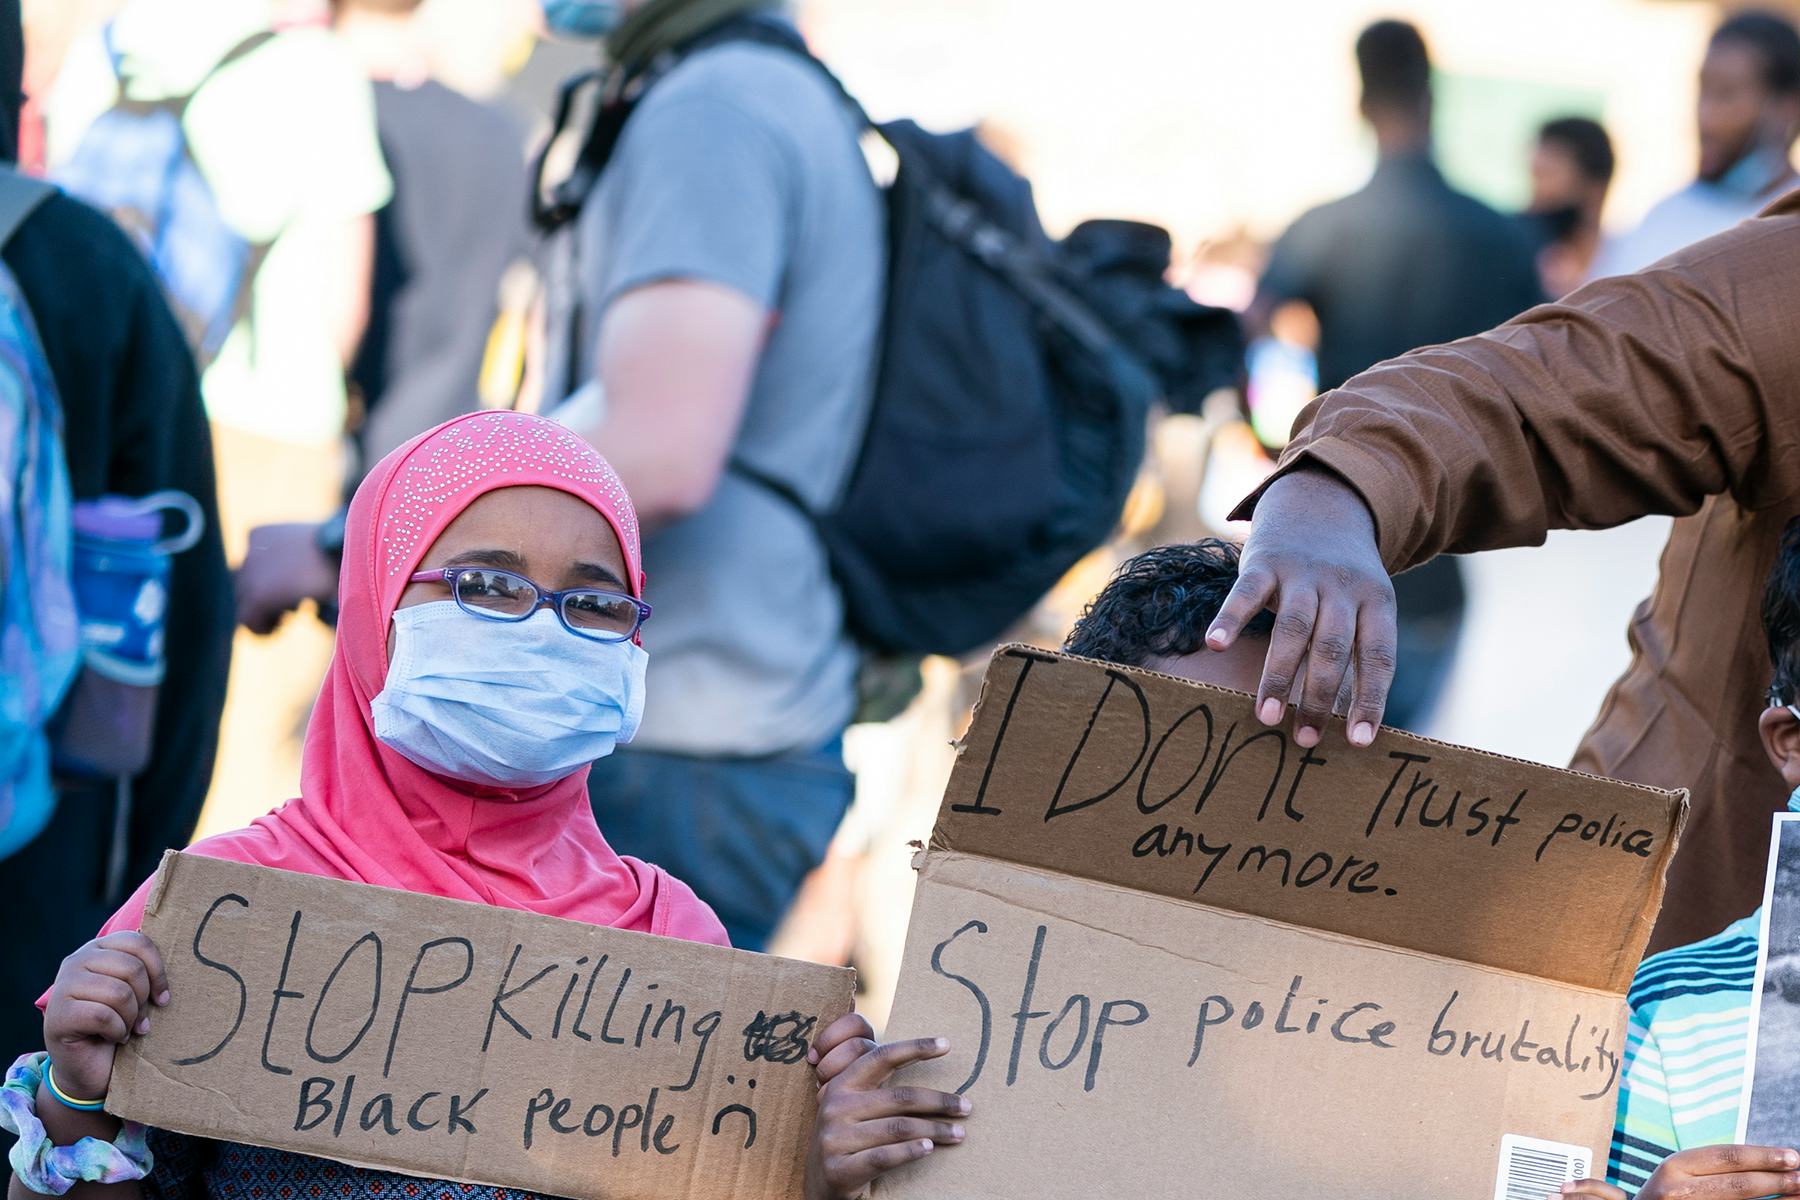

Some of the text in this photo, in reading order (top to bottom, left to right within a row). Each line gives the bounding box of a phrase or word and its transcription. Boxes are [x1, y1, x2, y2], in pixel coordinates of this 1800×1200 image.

[951, 653, 1059, 817] I
[1366, 751, 1522, 848] Trust
[1534, 813, 1654, 862] police
[1187, 975, 1398, 1069] police
[1426, 990, 1620, 1101] brutality
[292, 1076, 489, 1138] Black
